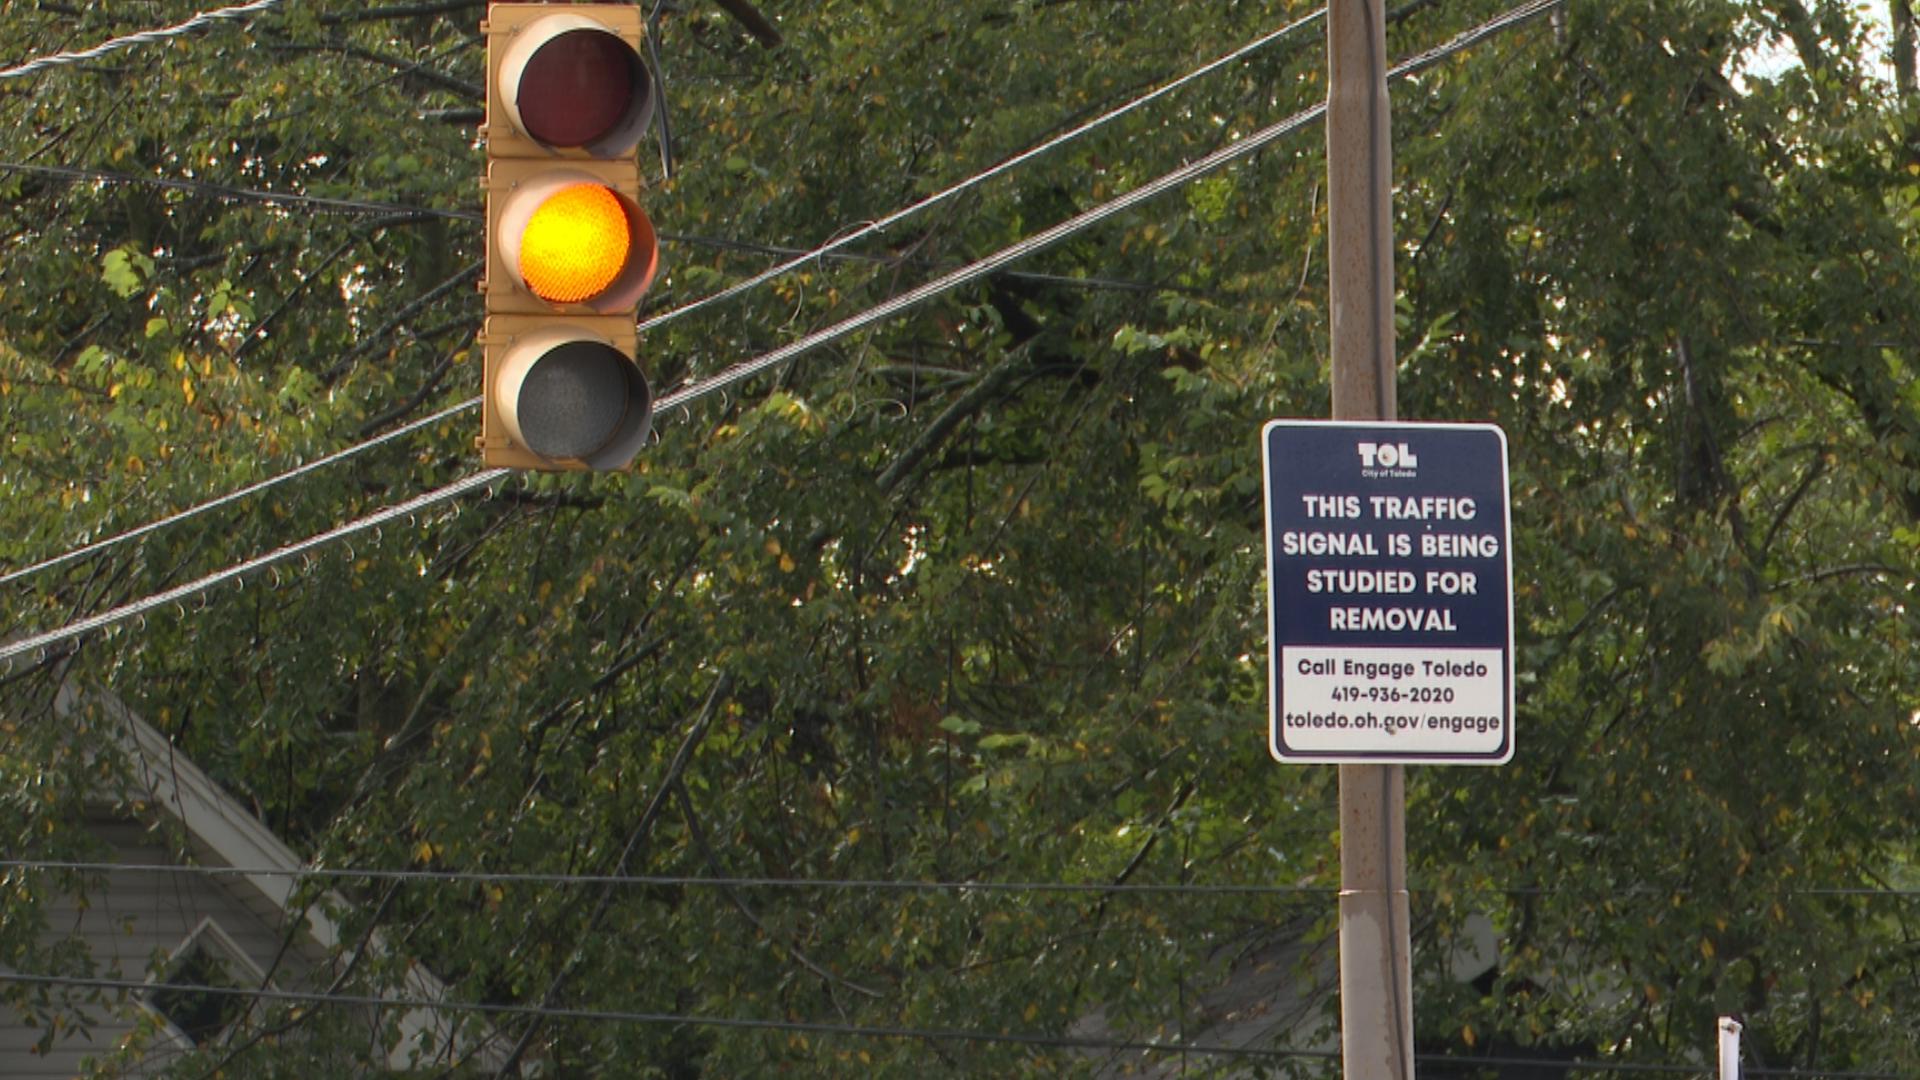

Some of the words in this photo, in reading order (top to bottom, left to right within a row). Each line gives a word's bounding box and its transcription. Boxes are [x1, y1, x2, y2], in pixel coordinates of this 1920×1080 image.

[1358, 442, 1418, 468] TOL
[1362, 469, 1378, 479] City
[1379, 469, 1388, 477] of
[1390, 470, 1417, 478] Toledo
[1302, 495, 1361, 518] THIS
[1369, 496, 1476, 520] TRAFFIC
[1283, 532, 1379, 556] SIGNAL
[1388, 534, 1411, 556] IS
[1422, 534, 1499, 558] BEING
[1307, 569, 1416, 594] STUDIED
[1426, 571, 1477, 595] FOR
[1330, 607, 1457, 632] REMOVAL
[1298, 658, 1336, 676] Call
[1344, 659, 1415, 680] Engage
[1422, 660, 1488, 677] Toledo
[1331, 687, 1455, 703] 419-936-2020
[1286, 711, 1500, 733] toledo.oh.gov/engage
